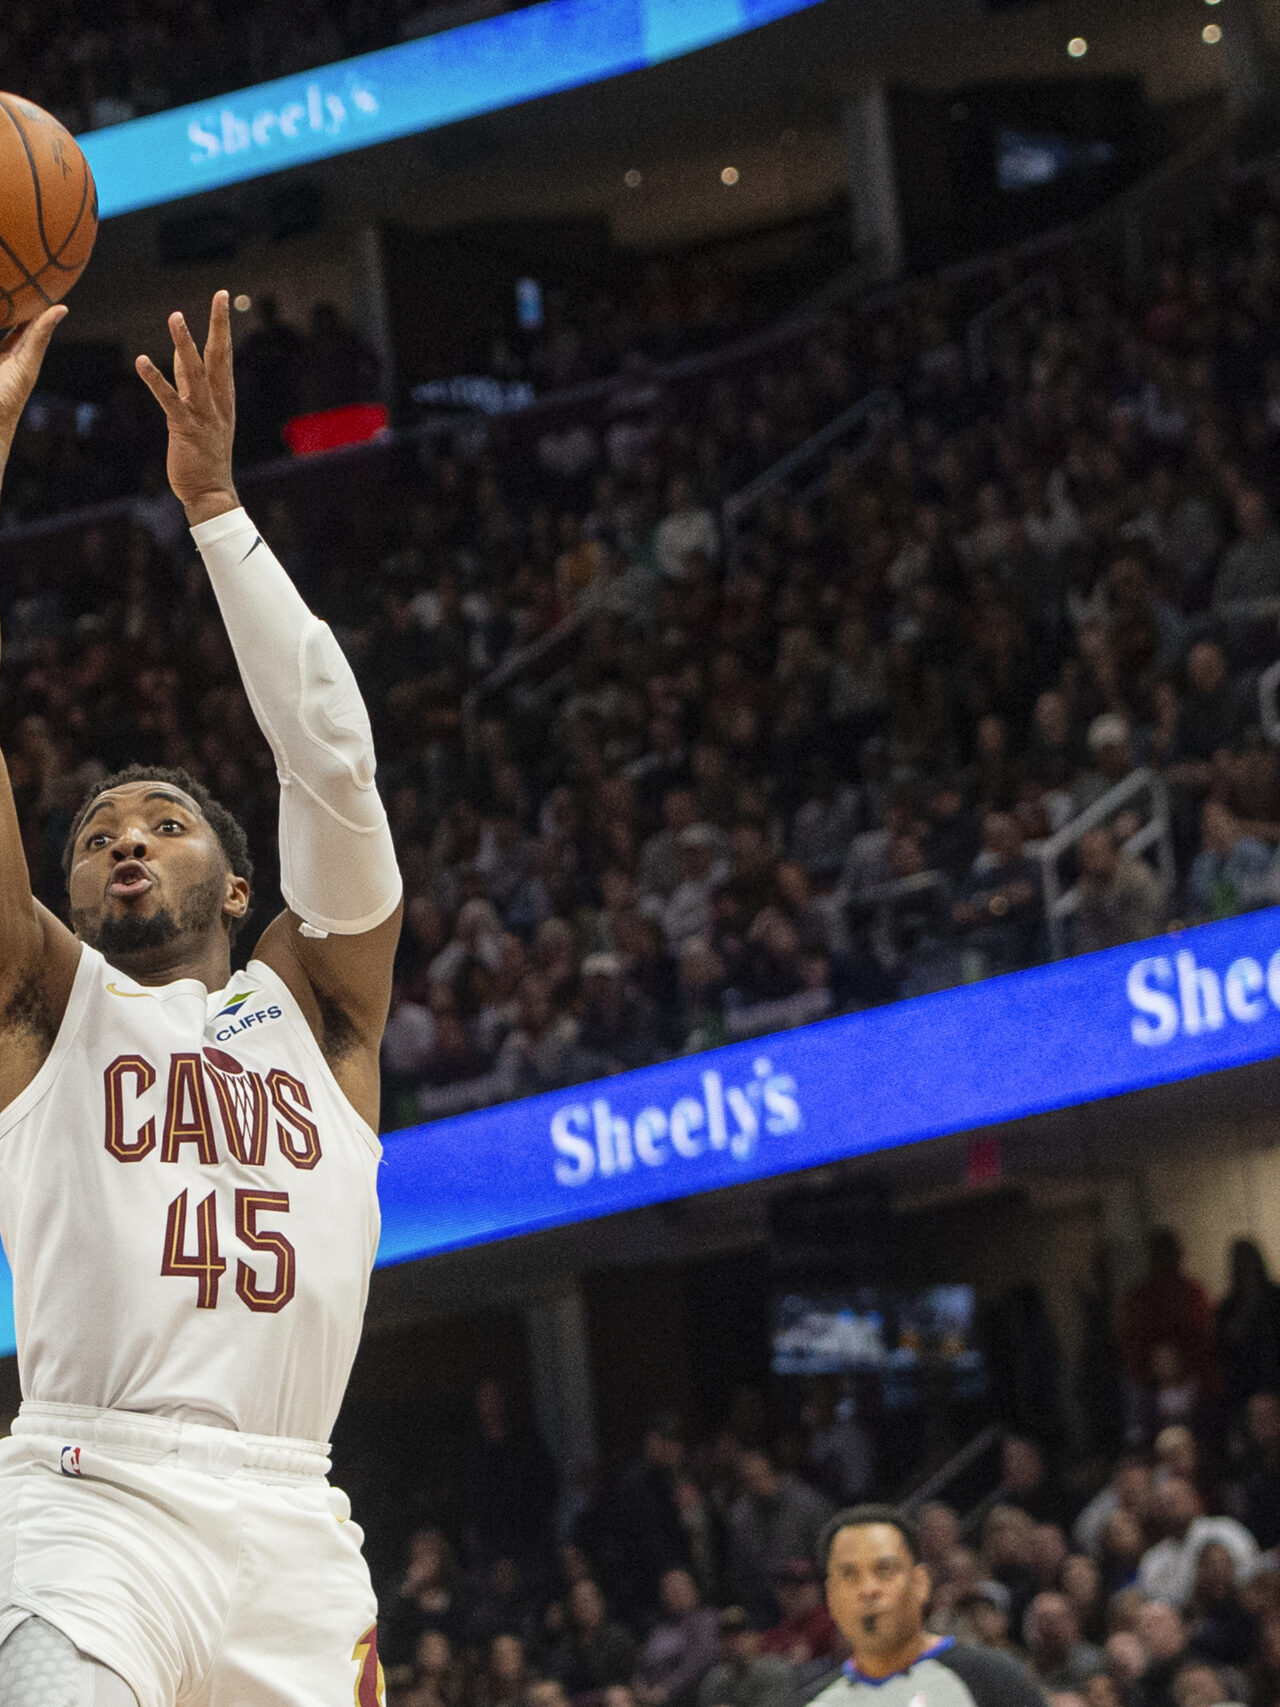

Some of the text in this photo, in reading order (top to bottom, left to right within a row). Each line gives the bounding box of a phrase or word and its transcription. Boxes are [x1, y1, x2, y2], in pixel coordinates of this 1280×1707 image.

[216, 1004, 283, 1043] CLIFFS
[1126, 948, 1280, 1047] She
[103, 1050, 323, 1171] CAVS
[550, 1056, 803, 1187] Sheely's
[160, 1187, 297, 1314] 45
